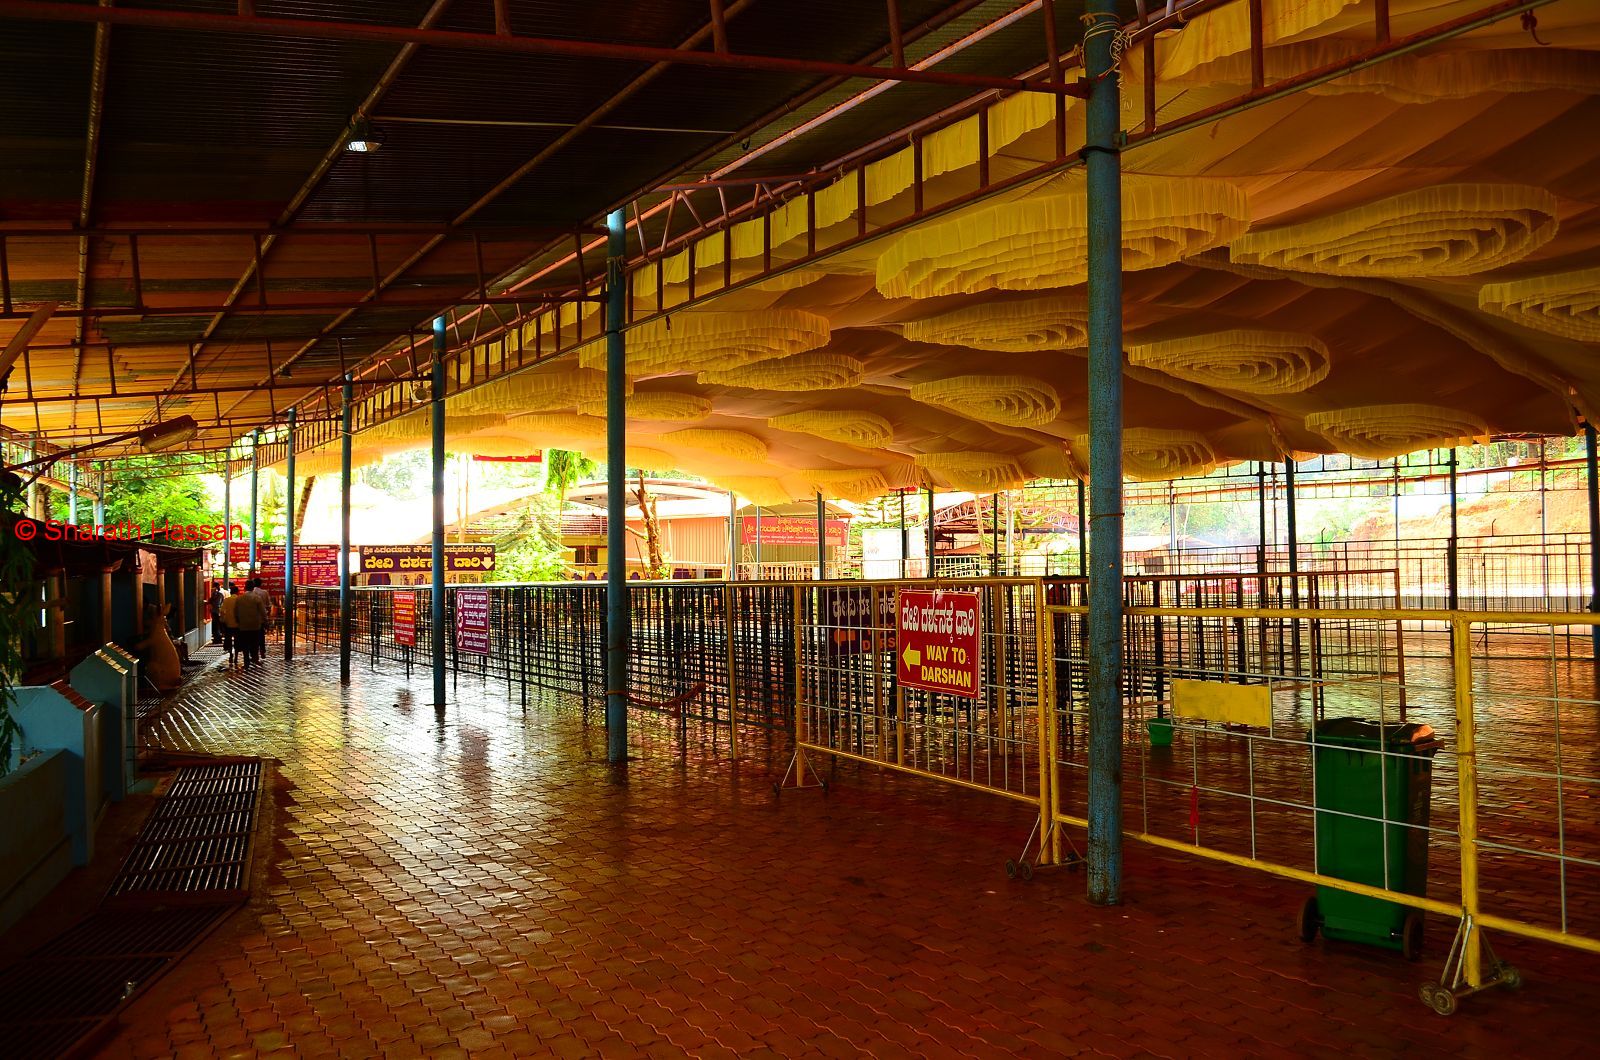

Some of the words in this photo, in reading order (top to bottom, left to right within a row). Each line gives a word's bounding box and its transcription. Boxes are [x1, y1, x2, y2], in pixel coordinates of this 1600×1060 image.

[364, 555, 394, 569] ದೇವಿ
[454, 556, 481, 568] ದಾರಿ
[902, 598, 919, 632] ದೇವಿ
[921, 601, 954, 643] ದರ್ಶನಕ್ಕೆ
[955, 608, 975, 637] ದಾರಿ
[926, 644, 949, 662] WAY
[952, 646, 967, 665] TO
[921, 665, 972, 688] DARSHAN
